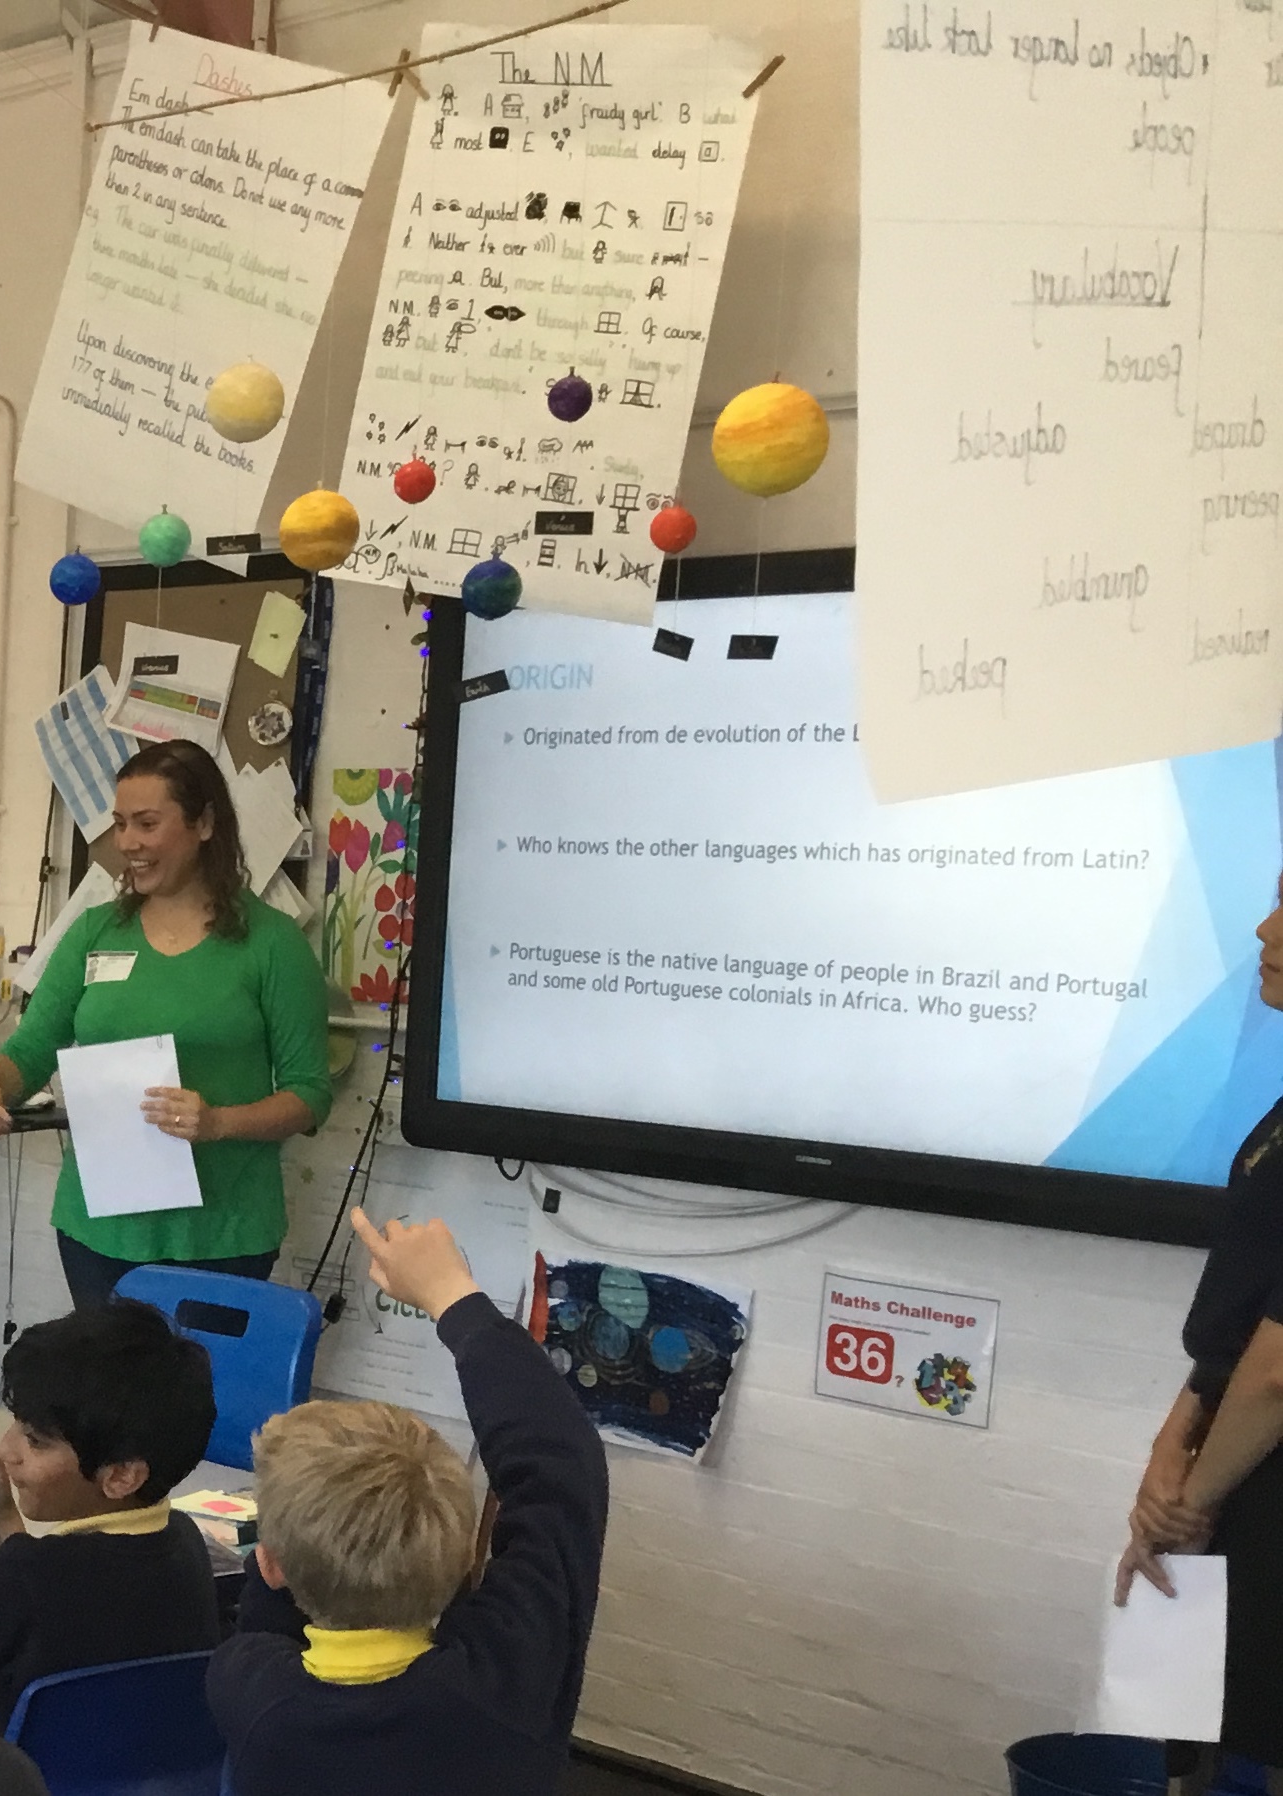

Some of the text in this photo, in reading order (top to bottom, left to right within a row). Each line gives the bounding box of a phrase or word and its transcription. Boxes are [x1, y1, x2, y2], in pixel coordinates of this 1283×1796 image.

[490, 51, 536, 84] The
[128, 78, 190, 116] Em dash
[191, 138, 213, 157] can
[217, 138, 241, 163] take
[245, 148, 264, 171] the
[264, 157, 298, 184] place
[303, 173, 317, 196] of
[322, 178, 332, 192] a
[454, 131, 484, 151] most
[652, 143, 686, 170] delay
[105, 172, 129, 196] than
[132, 182, 140, 199] 2
[143, 191, 153, 204] in
[155, 196, 177, 225] any
[173, 166, 188, 180] or
[268, 197, 286, 212] use
[290, 203, 311, 233] any
[314, 210, 345, 230] more
[465, 201, 519, 230] adjusted
[76, 318, 200, 389] Upon discovering the
[72, 355, 182, 412] 177 of them the
[137, 418, 187, 448] recalled
[193, 434, 212, 457] the
[508, 664, 594, 691] ORIGIN
[523, 726, 613, 750] Originated
[617, 725, 659, 745] from
[665, 725, 686, 745] de
[693, 723, 781, 744] evolution
[787, 723, 807, 743] of
[813, 722, 845, 743] the
[516, 836, 1150, 870] Who knows the other languages which has originated from Latin?
[509, 942, 1148, 1001] Portuguese is the native language of people in Brazil and Portugal
[508, 970, 1037, 1024] and some old Portuguese colonials in Africa. Who guess?
[830, 1291, 882, 1312] Maths
[887, 1301, 977, 1329] Challenge
[833, 1331, 904, 1388] 36 ?
